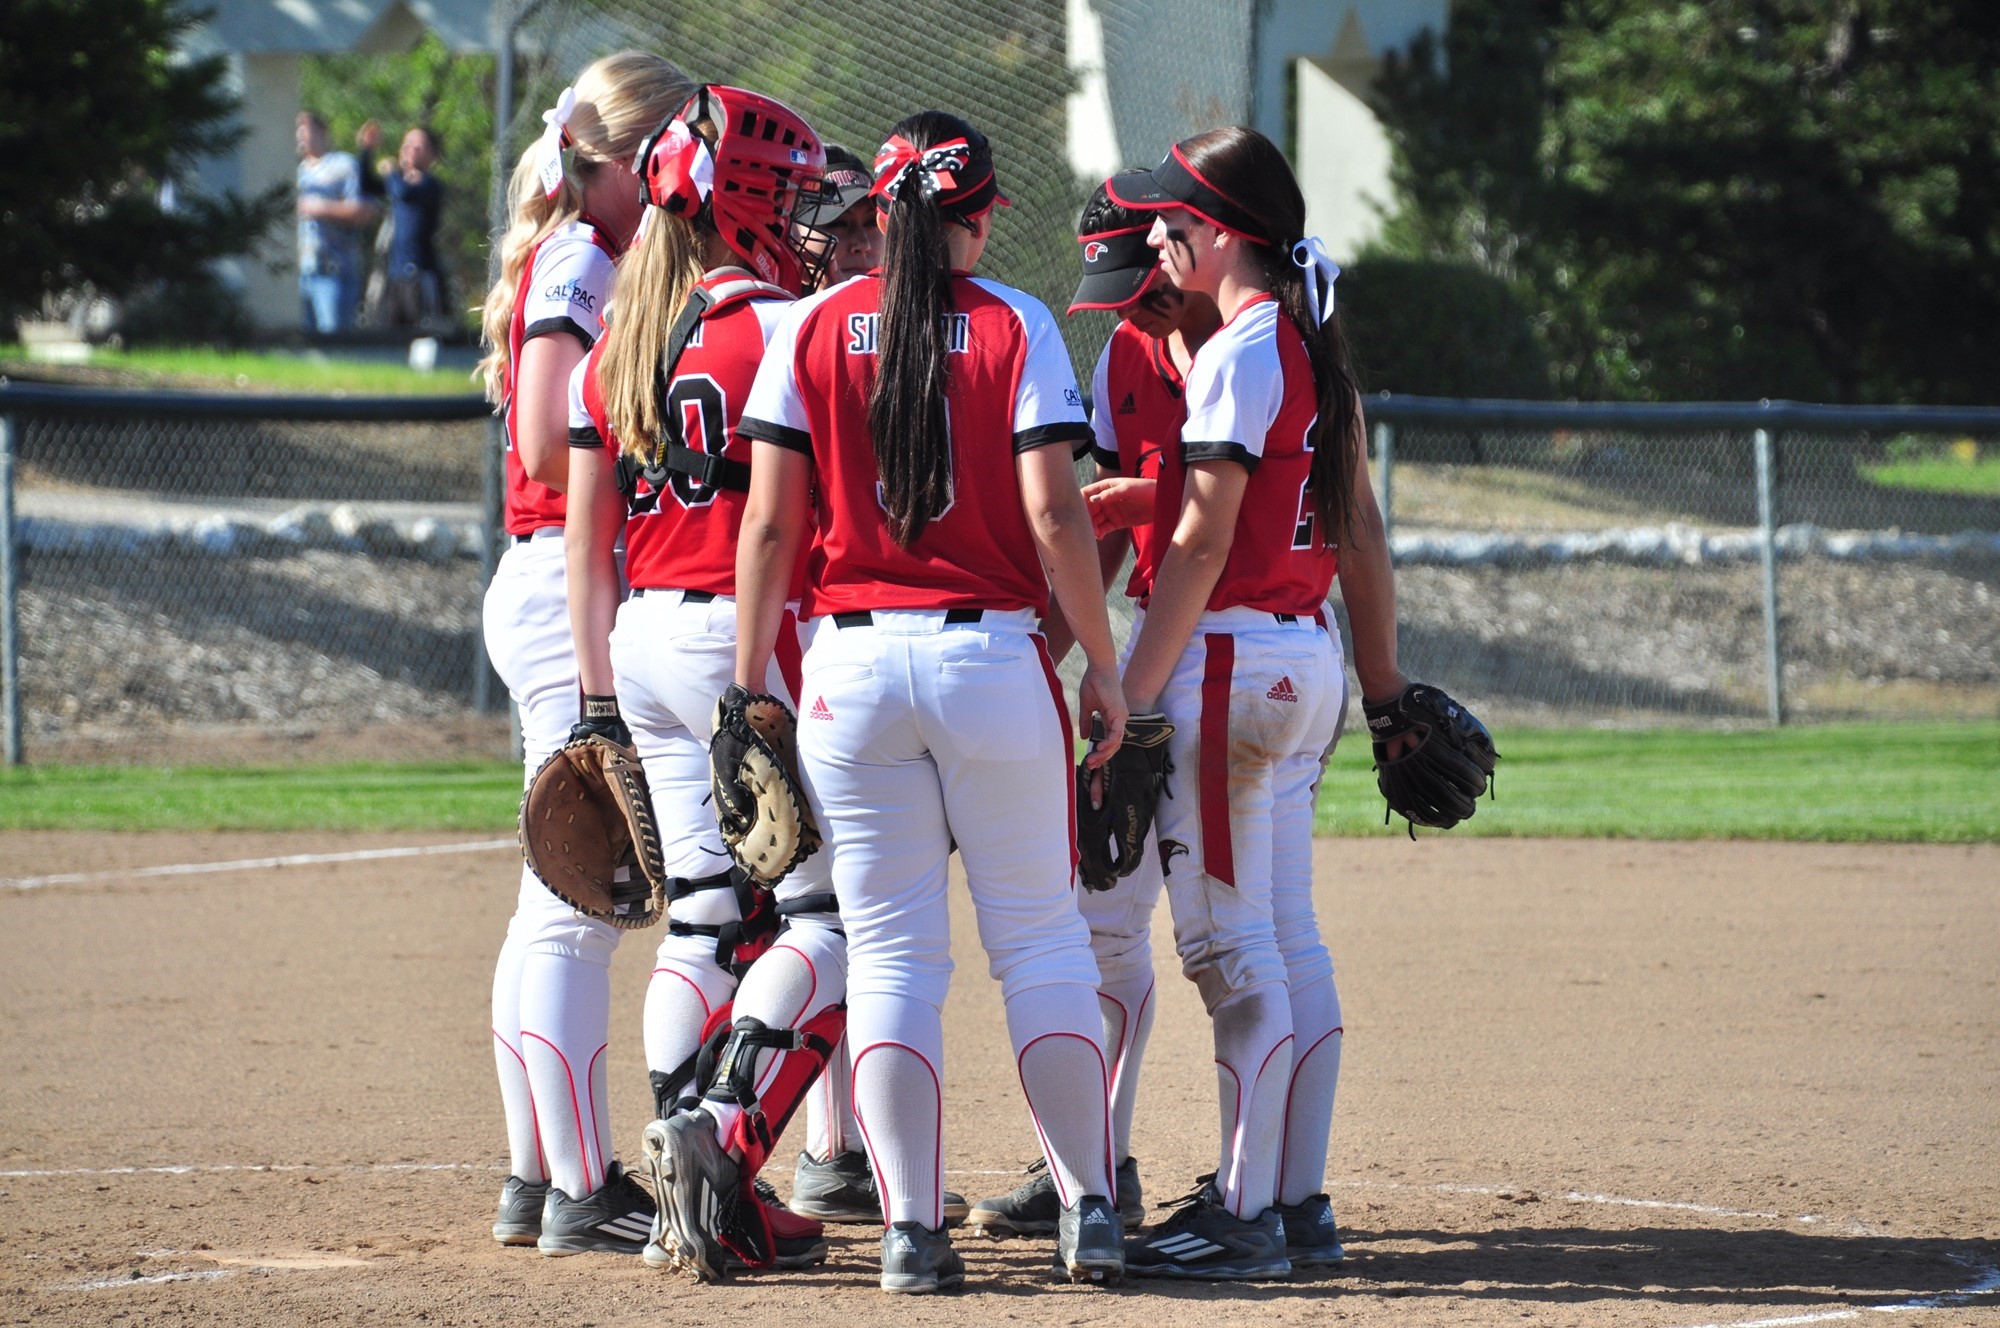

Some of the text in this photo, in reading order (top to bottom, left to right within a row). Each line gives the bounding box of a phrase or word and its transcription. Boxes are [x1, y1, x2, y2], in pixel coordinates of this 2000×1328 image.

[545, 285, 568, 298] CAL
[571, 285, 596, 309] PAC
[1266, 690, 1298, 703] adidas
[809, 710, 834, 721] adidas
[1083, 1217, 1110, 1225] adidas
